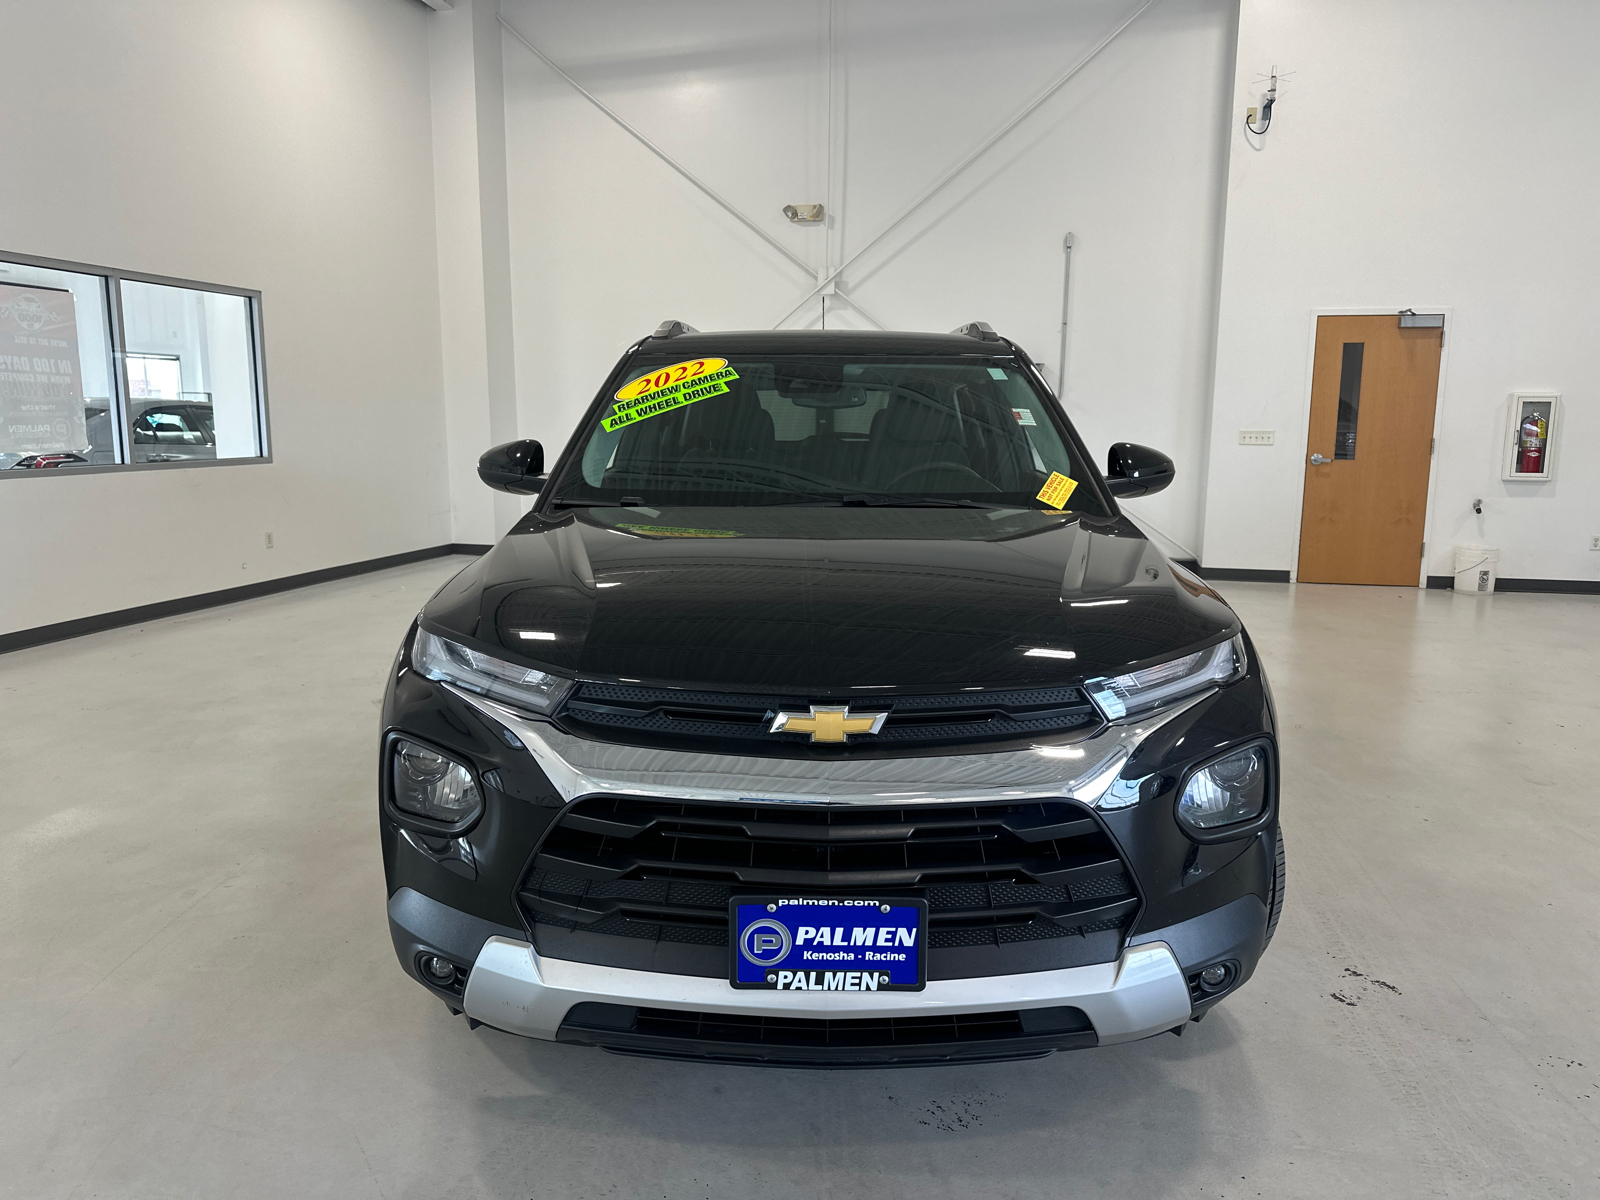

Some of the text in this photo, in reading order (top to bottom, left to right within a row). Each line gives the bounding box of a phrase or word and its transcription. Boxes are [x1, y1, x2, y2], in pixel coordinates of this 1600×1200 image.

[636, 361, 705, 396] 2022
[617, 369, 734, 413] REARVIEW CAMERA
[609, 383, 723, 428] ALL WHEEL DRIVE
[778, 898, 880, 907] palmen.com
[795, 926, 917, 947] PALMEN
[803, 950, 855, 961] Kenosha
[865, 951, 907, 961] Racine
[776, 971, 880, 991] PALMEN
